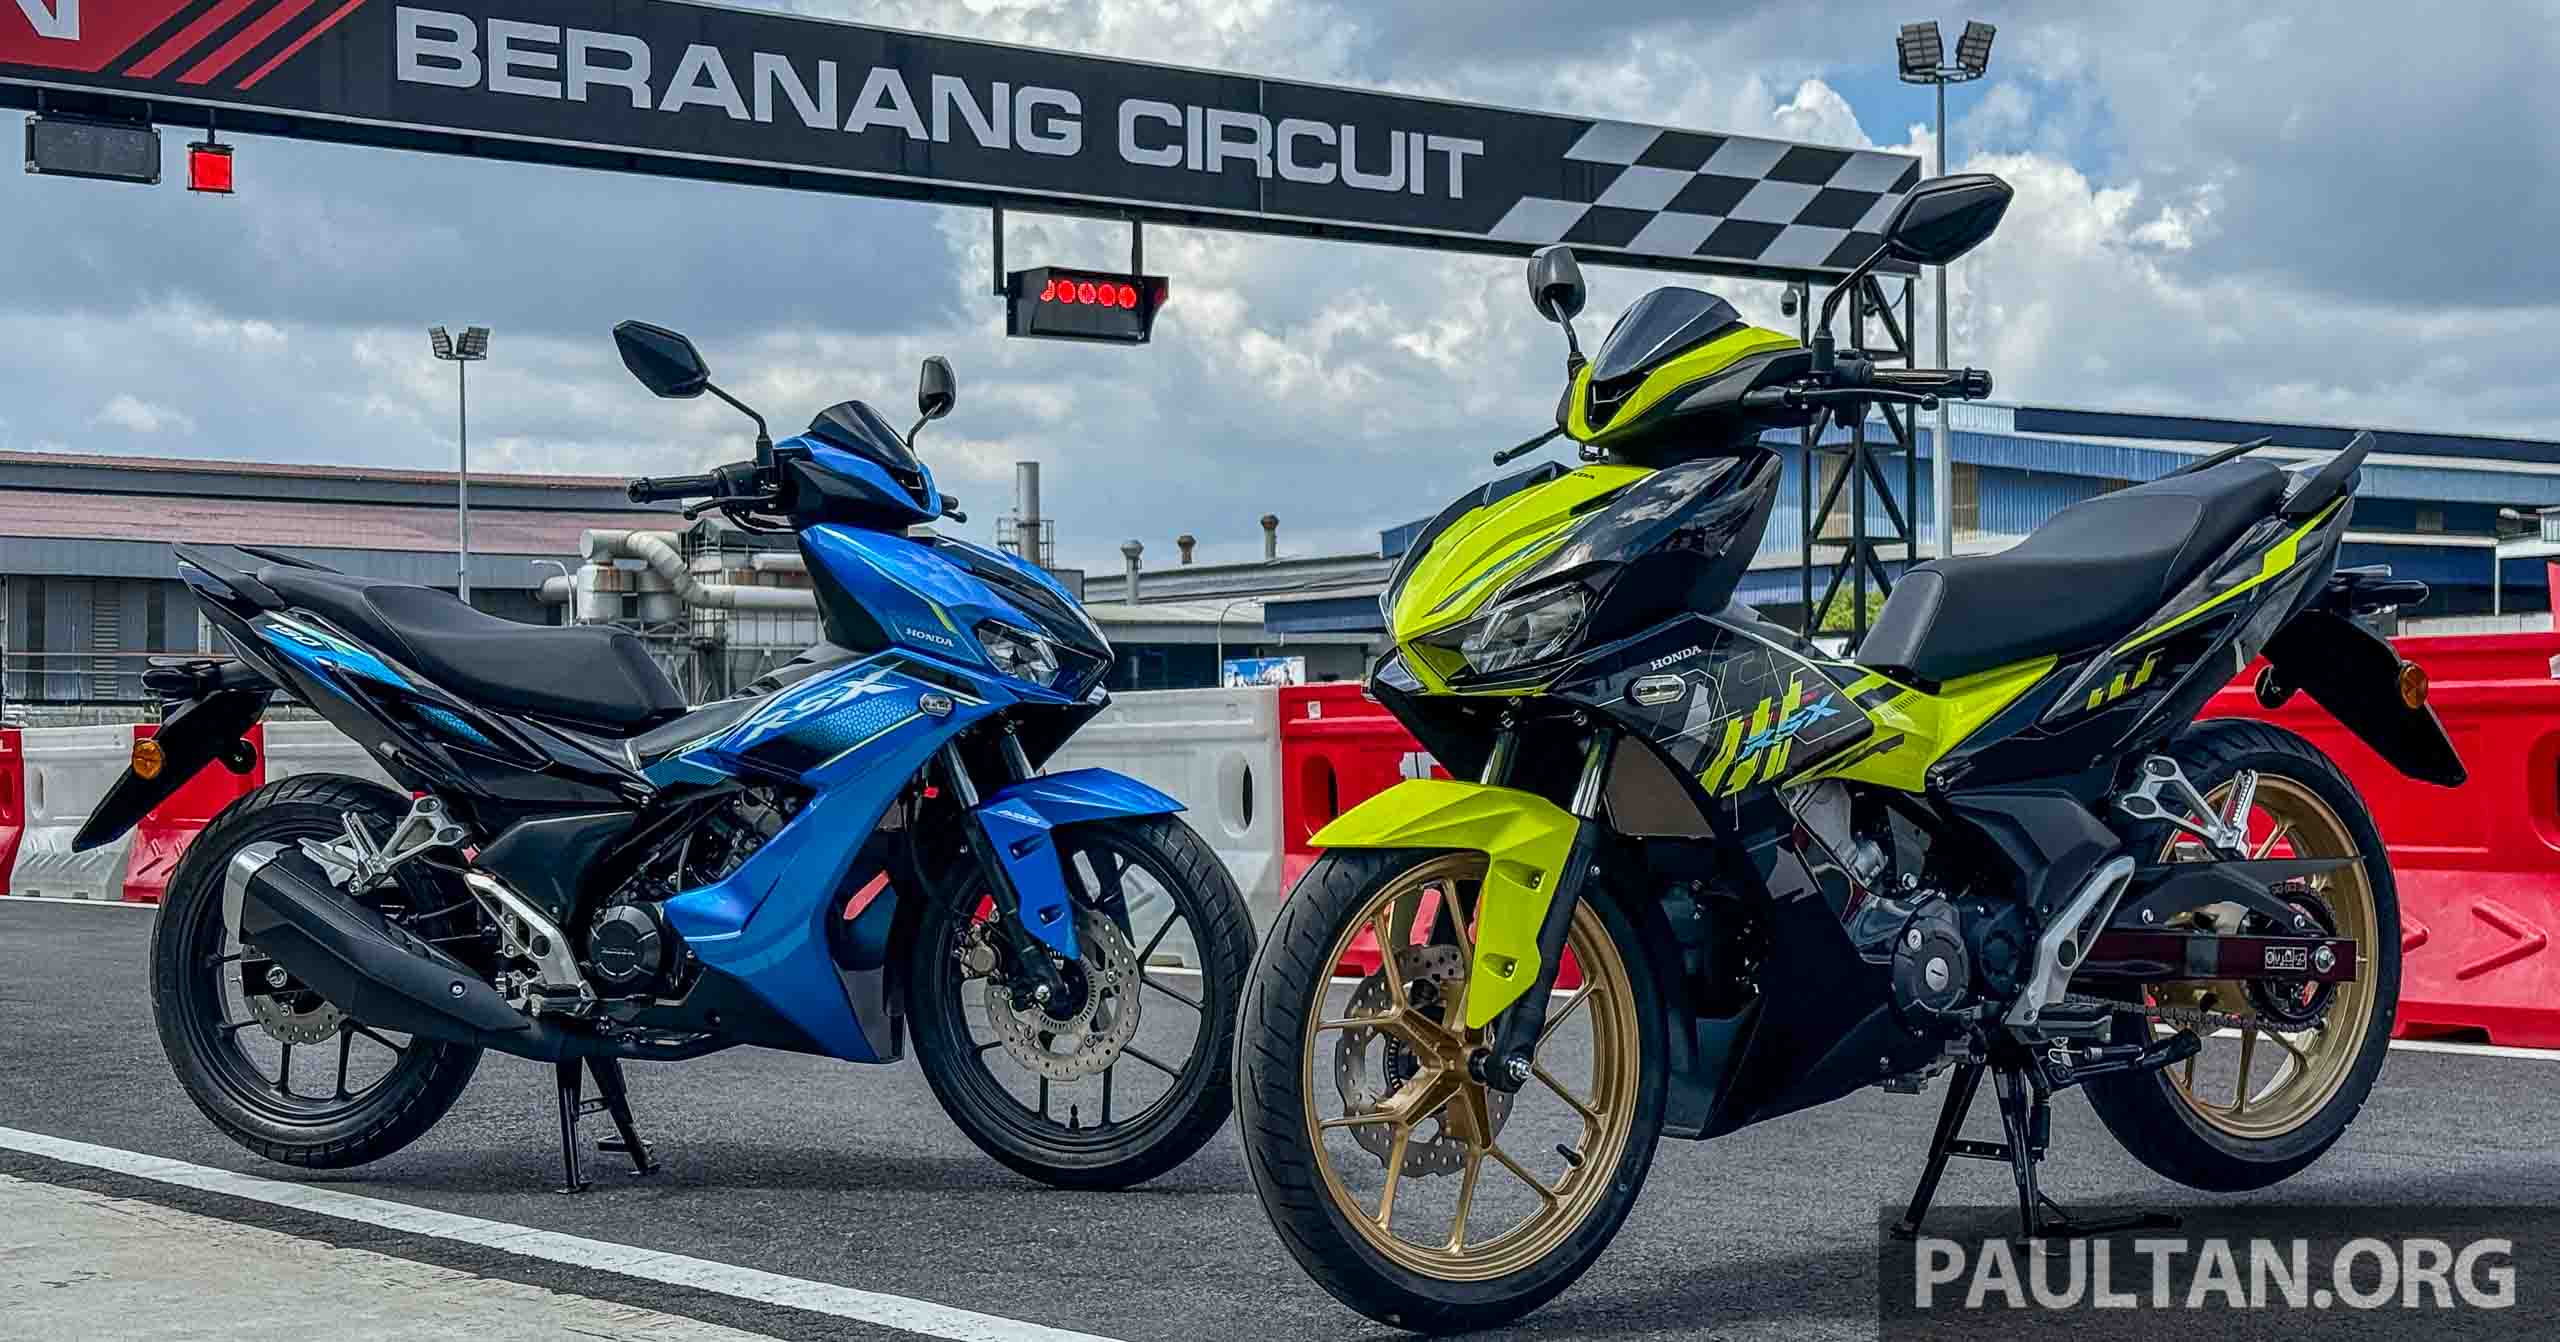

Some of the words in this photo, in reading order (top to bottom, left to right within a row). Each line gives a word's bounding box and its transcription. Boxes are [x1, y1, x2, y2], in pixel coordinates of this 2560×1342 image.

[396, 6, 1083, 157] BERANANG
[1117, 98, 1485, 200] CIRCUIT
[905, 627, 955, 648] HONDA
[1650, 644, 1702, 671] HONDA
